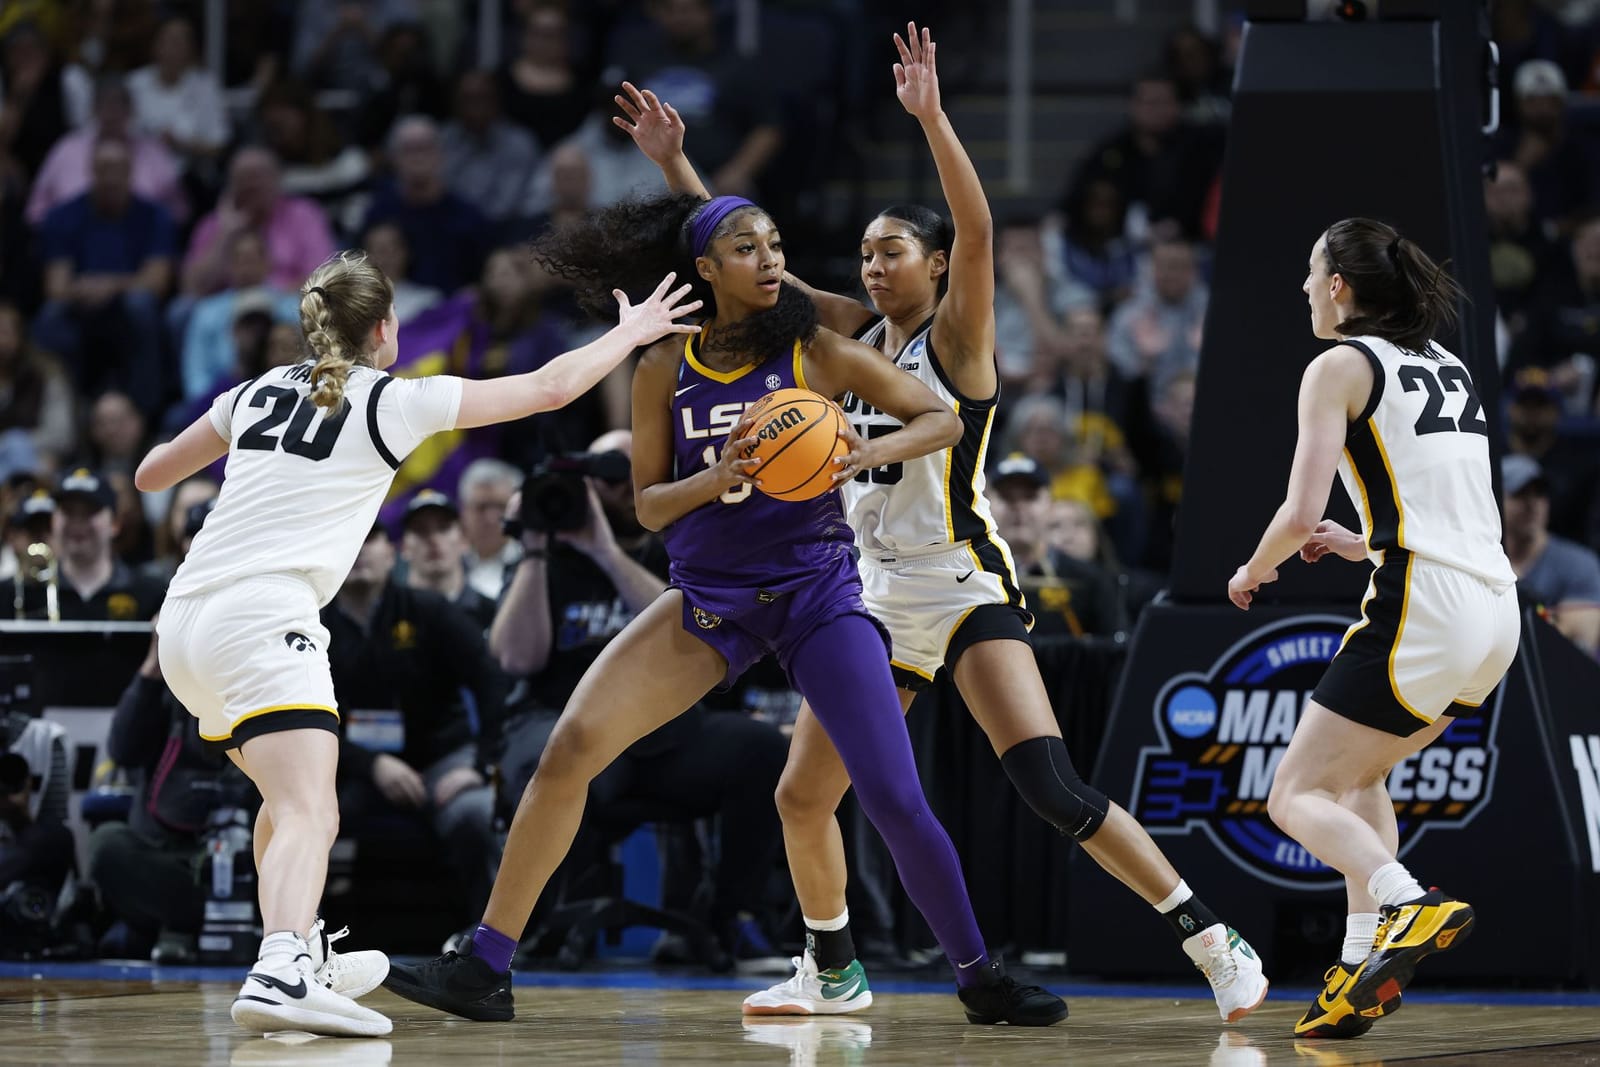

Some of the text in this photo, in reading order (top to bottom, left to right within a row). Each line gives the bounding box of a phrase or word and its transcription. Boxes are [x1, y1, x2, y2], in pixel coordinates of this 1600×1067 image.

[765, 375, 781, 390] SEC
[1397, 364, 1488, 437] 22
[237, 384, 352, 462] 20
[681, 402, 757, 440] LS
[1266, 636, 1334, 668] SWEET
[1217, 689, 1313, 744] MA
[1237, 745, 1487, 801] MESS
